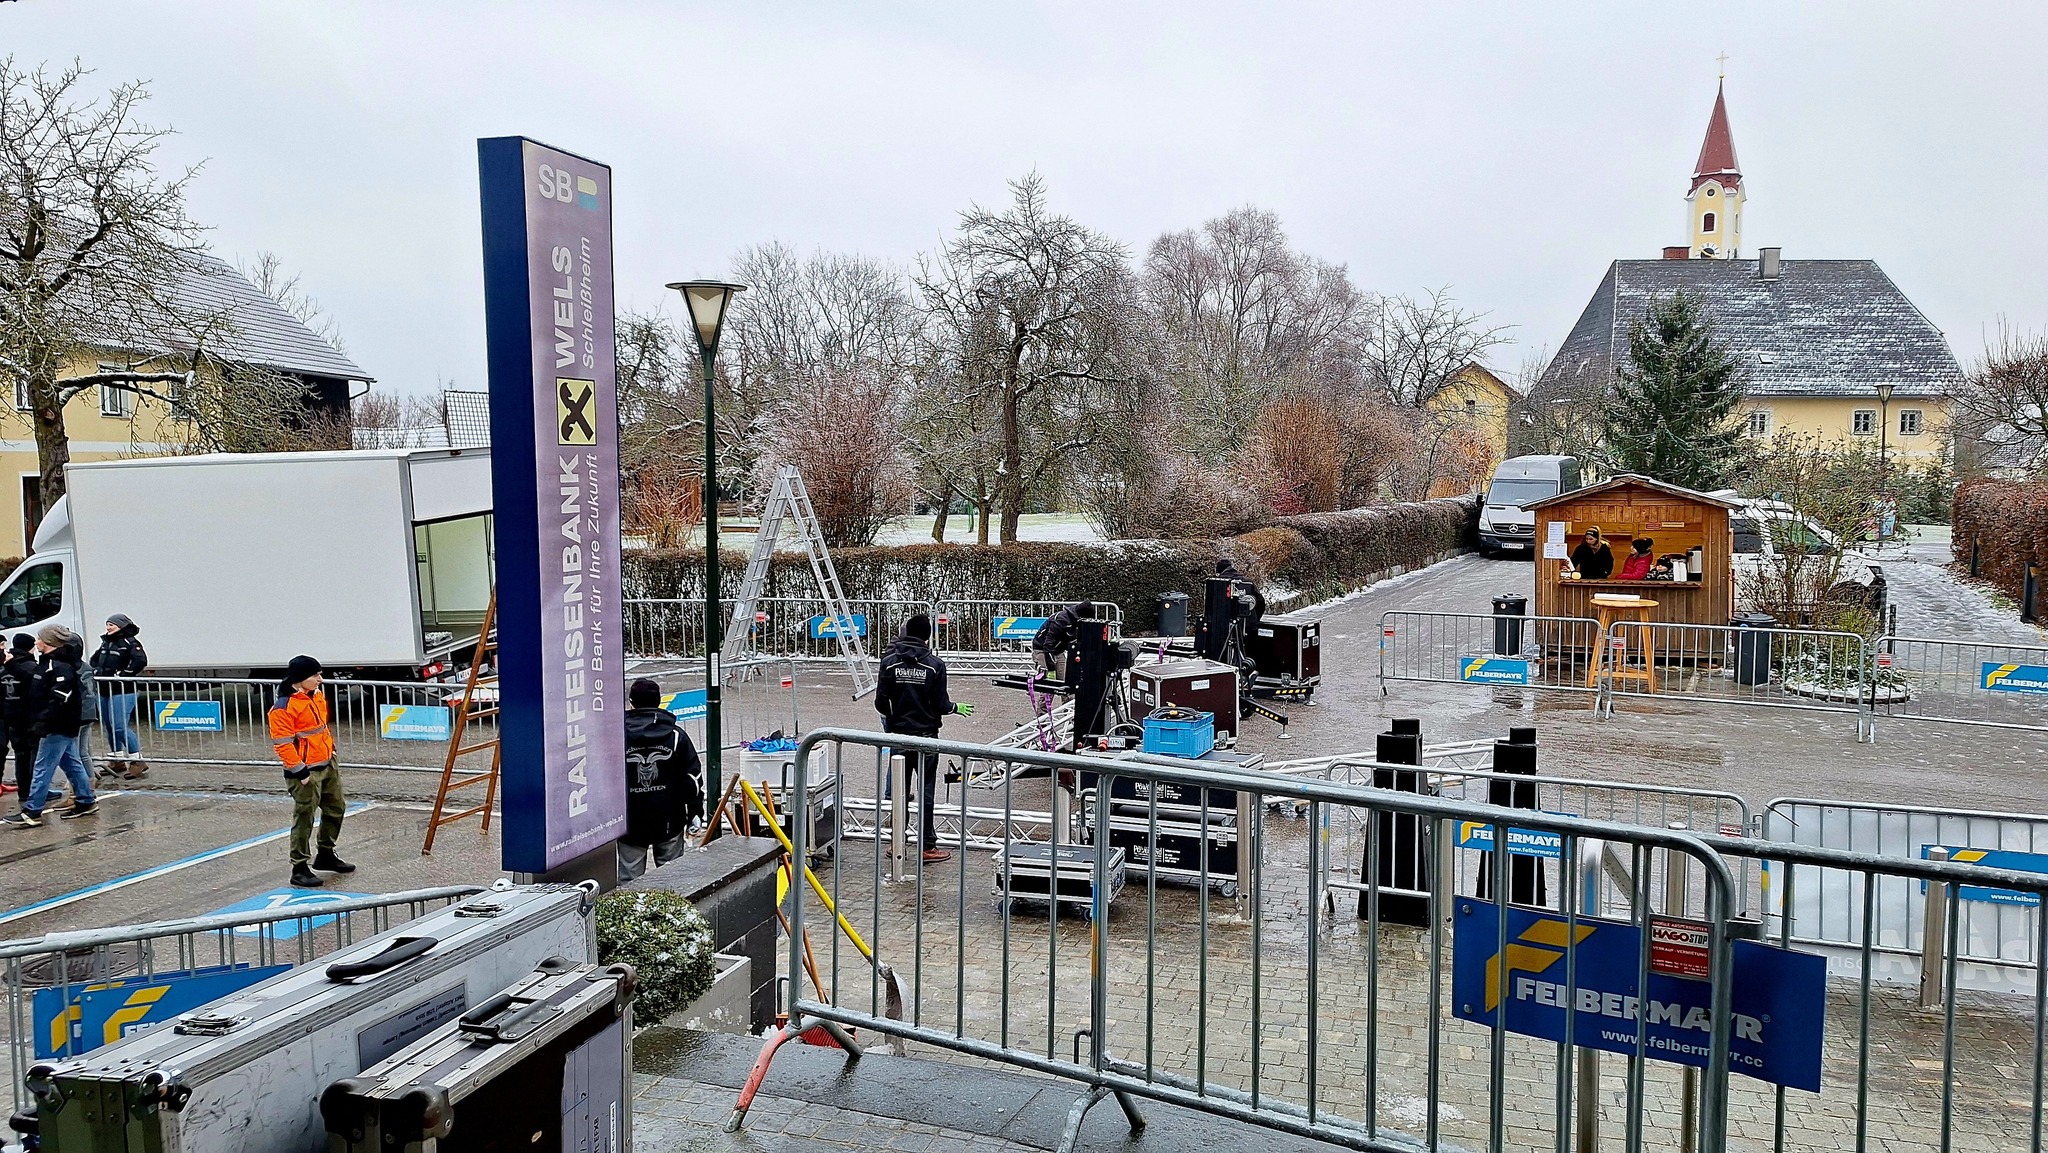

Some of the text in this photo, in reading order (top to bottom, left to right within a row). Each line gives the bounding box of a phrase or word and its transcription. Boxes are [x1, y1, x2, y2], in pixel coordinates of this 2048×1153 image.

[538, 164, 573, 204] SB
[579, 236, 595, 370] Schleißheim
[551, 244, 588, 818] RAIFFEISENBANK WELS
[586, 453, 604, 712] Die Bank für Ihre Zukunft
[1471, 670, 1522, 680] FELBERMAYR
[1995, 678, 2048, 689] FELBERMA
[165, 716, 216, 725] FELBERMAYR
[389, 724, 446, 733] FELBERMAYR
[1472, 829, 1561, 847] FELERMAYR
[1516, 976, 1764, 1044] FELBERMAR
[1601, 1029, 1764, 1068] www.felbermr.cc
